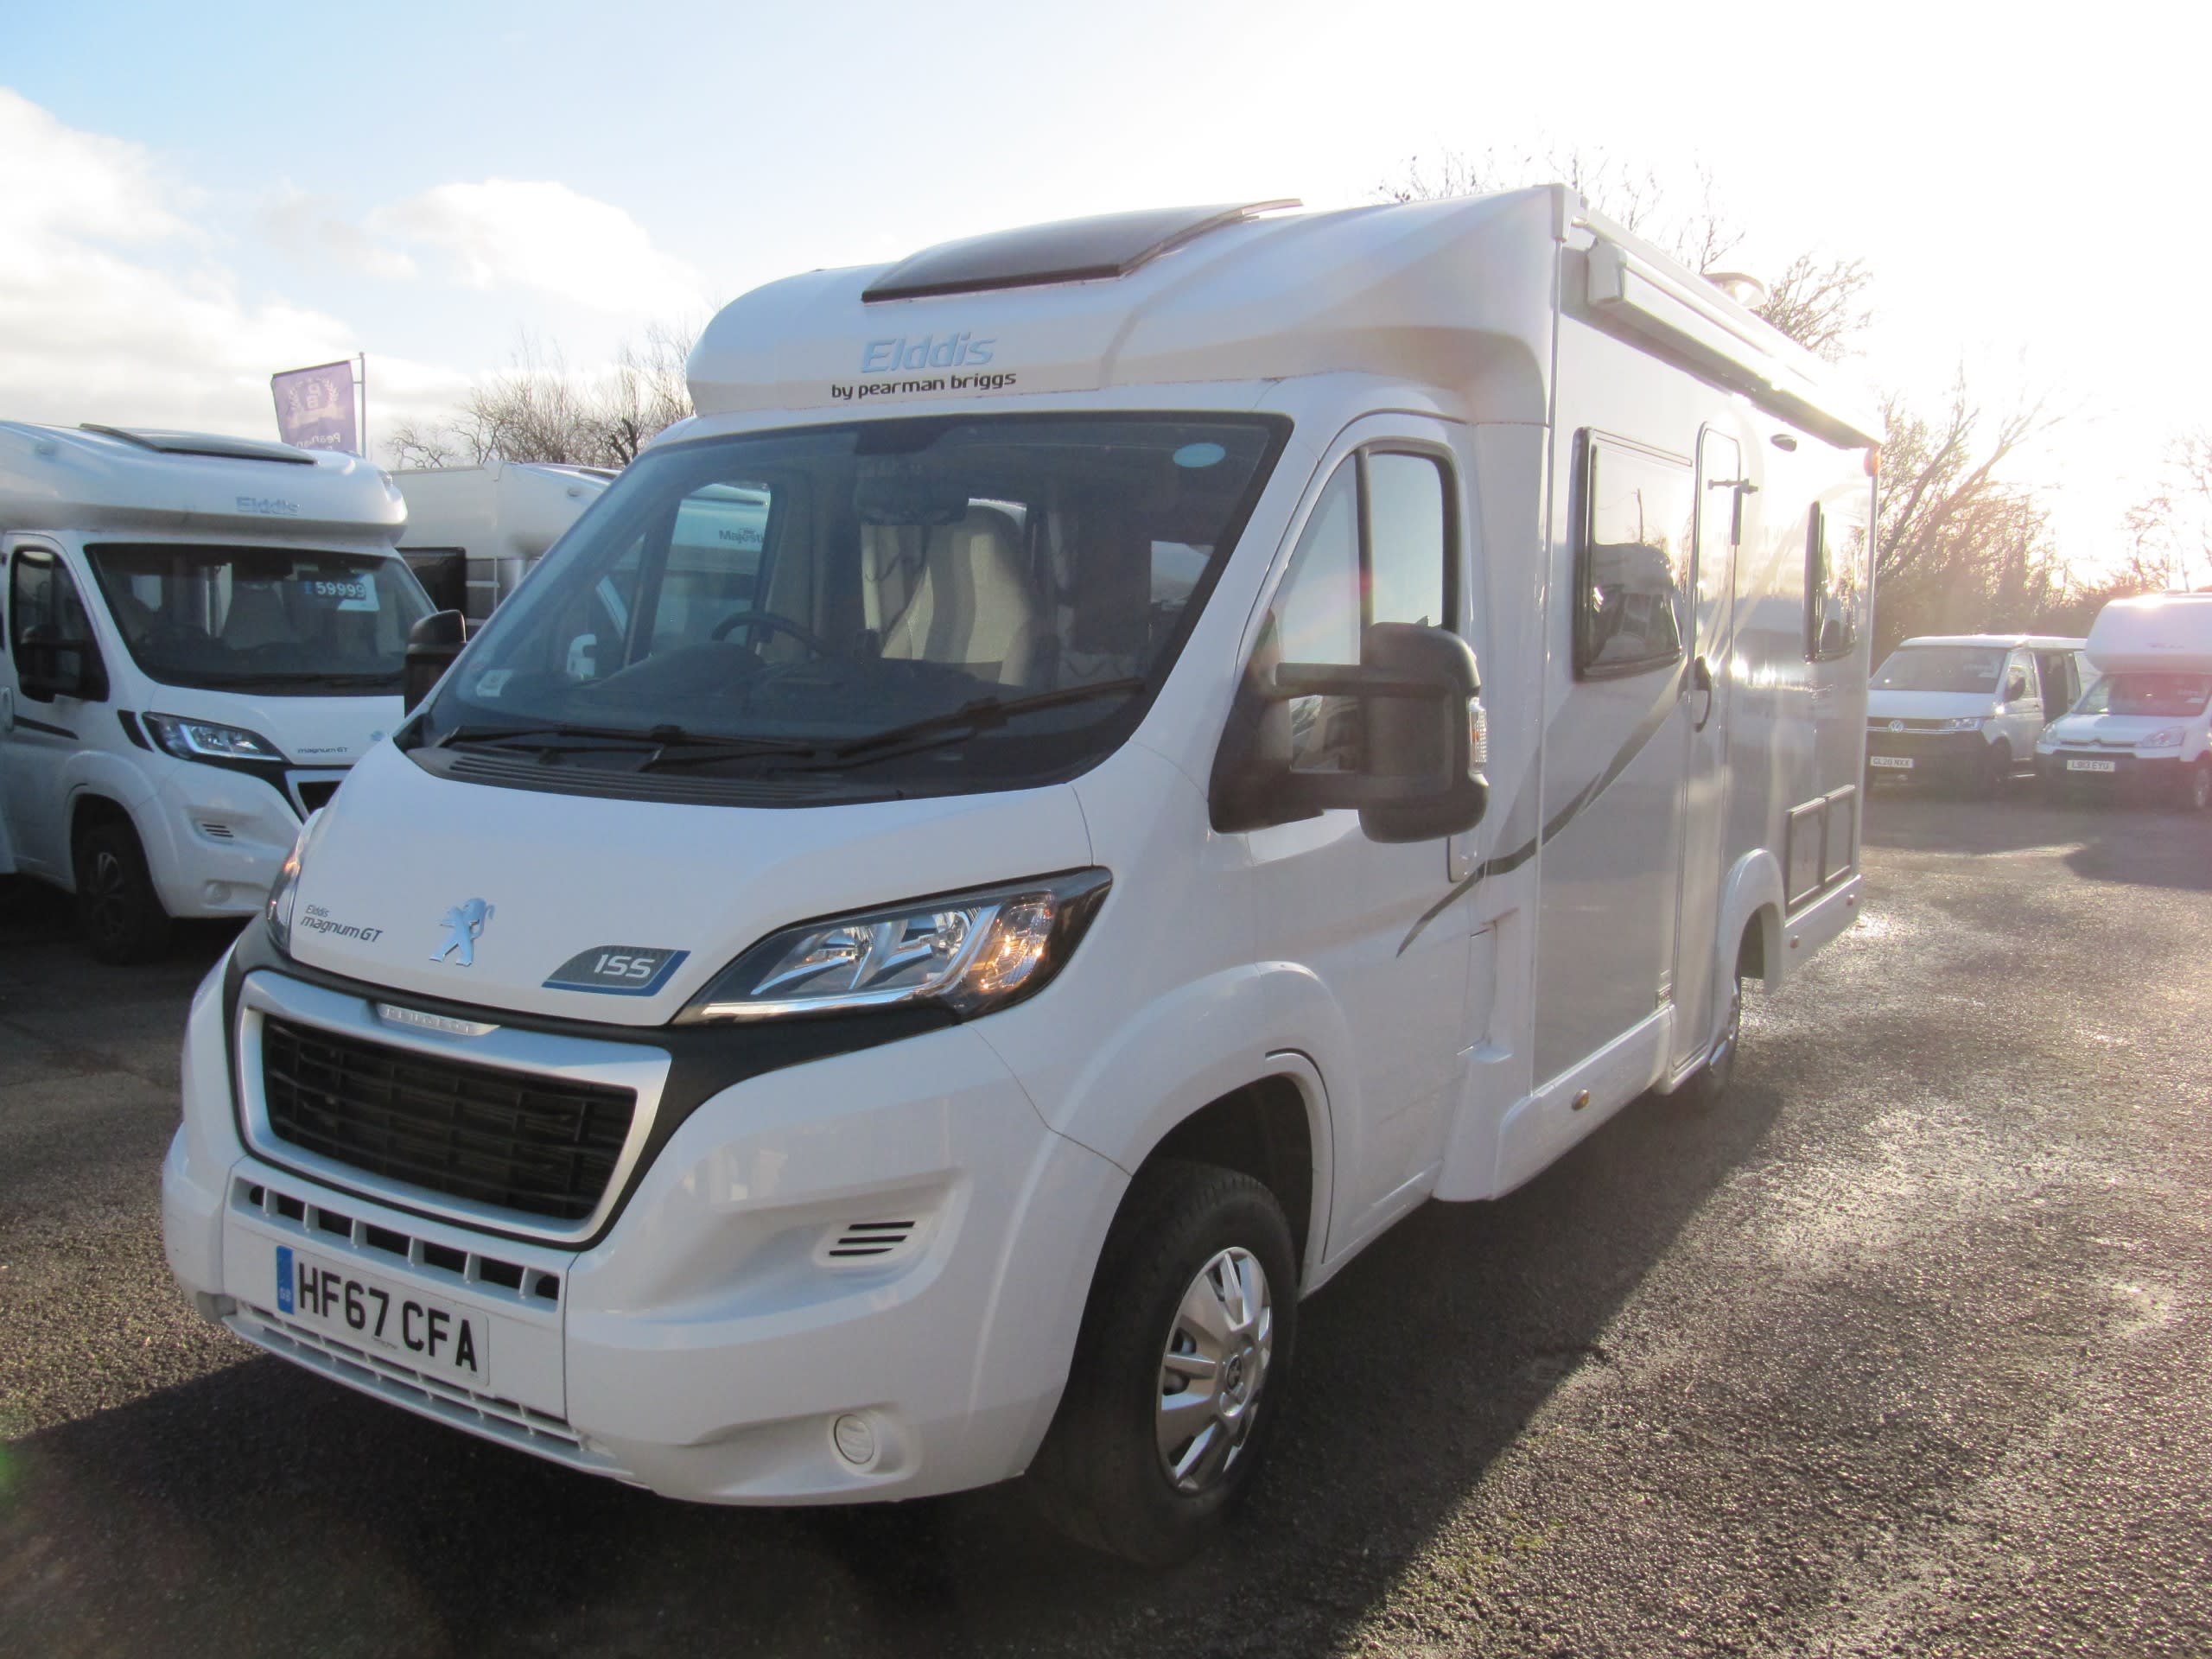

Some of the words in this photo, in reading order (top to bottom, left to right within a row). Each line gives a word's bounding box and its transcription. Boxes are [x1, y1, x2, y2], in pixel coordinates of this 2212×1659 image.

[861, 331, 996, 373] Elddis
[831, 384, 853, 400] by
[858, 378, 945, 398] pearman
[950, 372, 1017, 391] briggs
[315, 581, 365, 597] 59999
[300, 916, 359, 938] magnum
[360, 928, 384, 943] GT
[594, 954, 657, 978] 155
[298, 1262, 390, 1338] HF67
[403, 1300, 478, 1373] CFA
